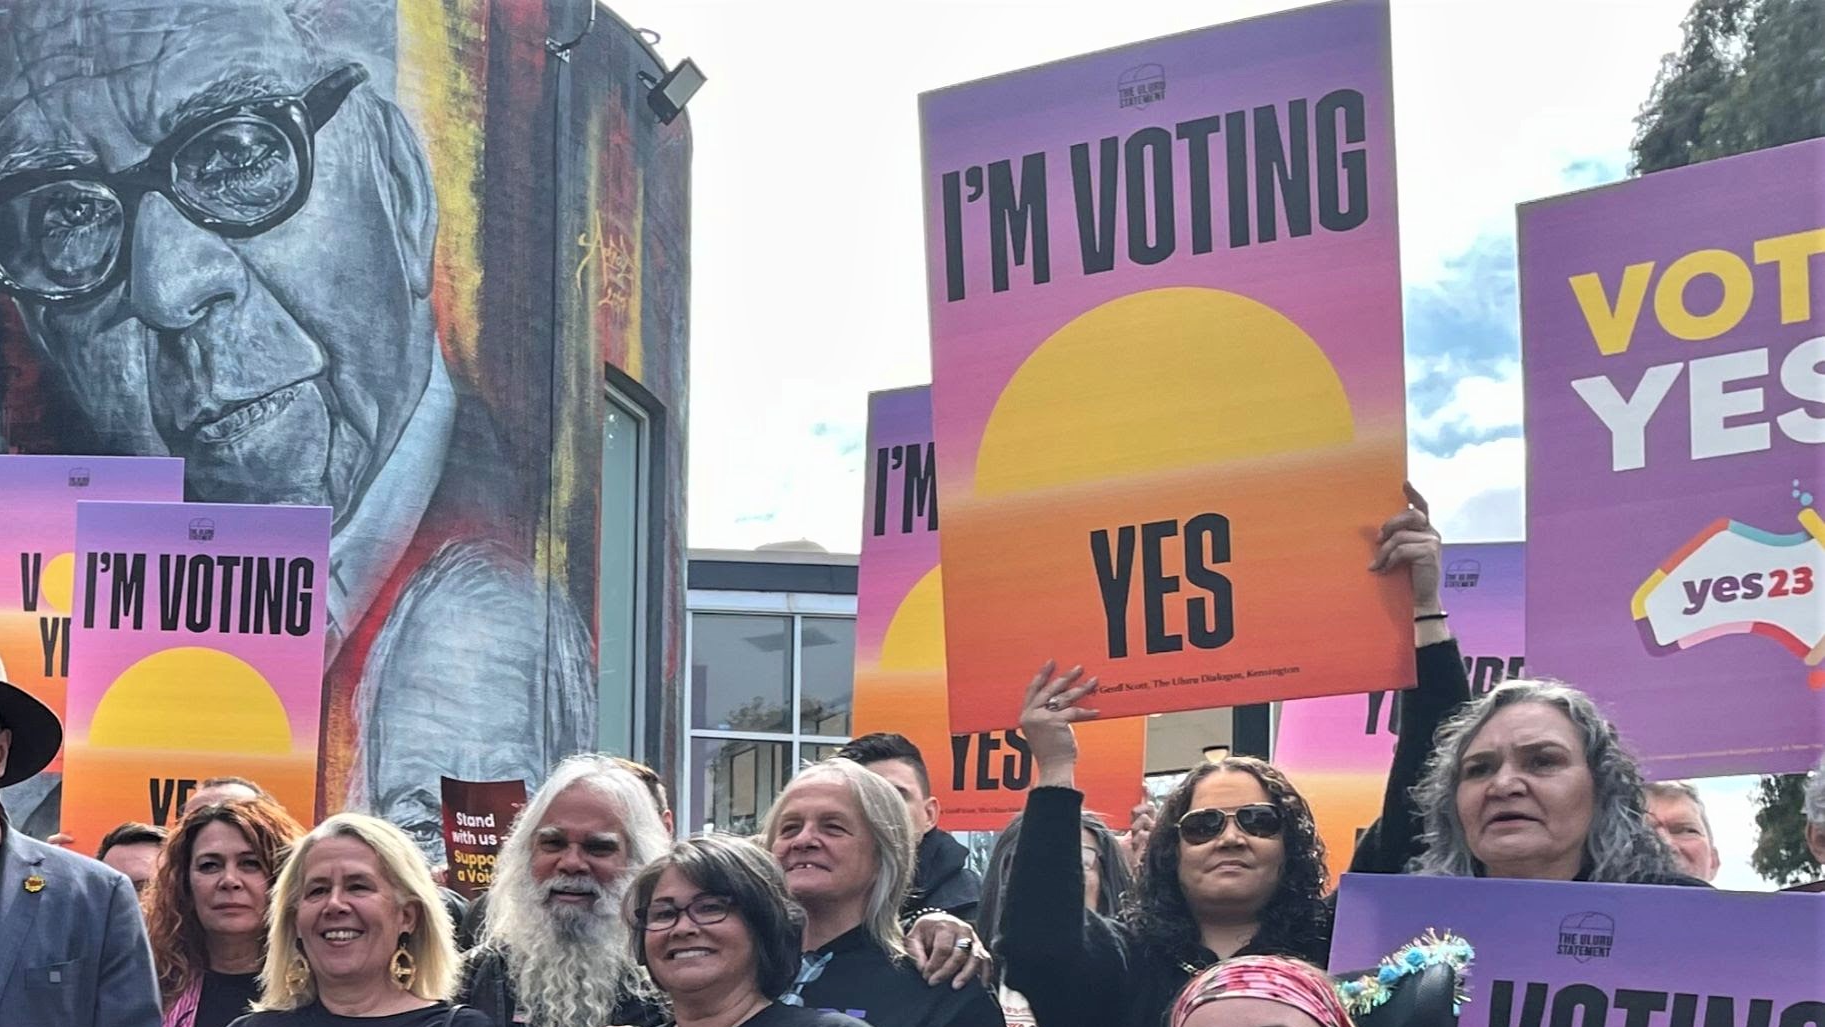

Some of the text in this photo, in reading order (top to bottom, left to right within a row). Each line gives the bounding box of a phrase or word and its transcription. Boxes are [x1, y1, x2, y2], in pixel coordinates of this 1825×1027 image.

[942, 88, 1370, 302] I'M VOTING
[1570, 230, 1825, 355] VOT
[874, 442, 938, 536] I'M
[84, 552, 314, 637] I'M VOTING
[1090, 513, 1235, 659] YES
[452, 829, 498, 846] with us
[455, 811, 496, 828] Stand
[457, 869, 466, 882] a
